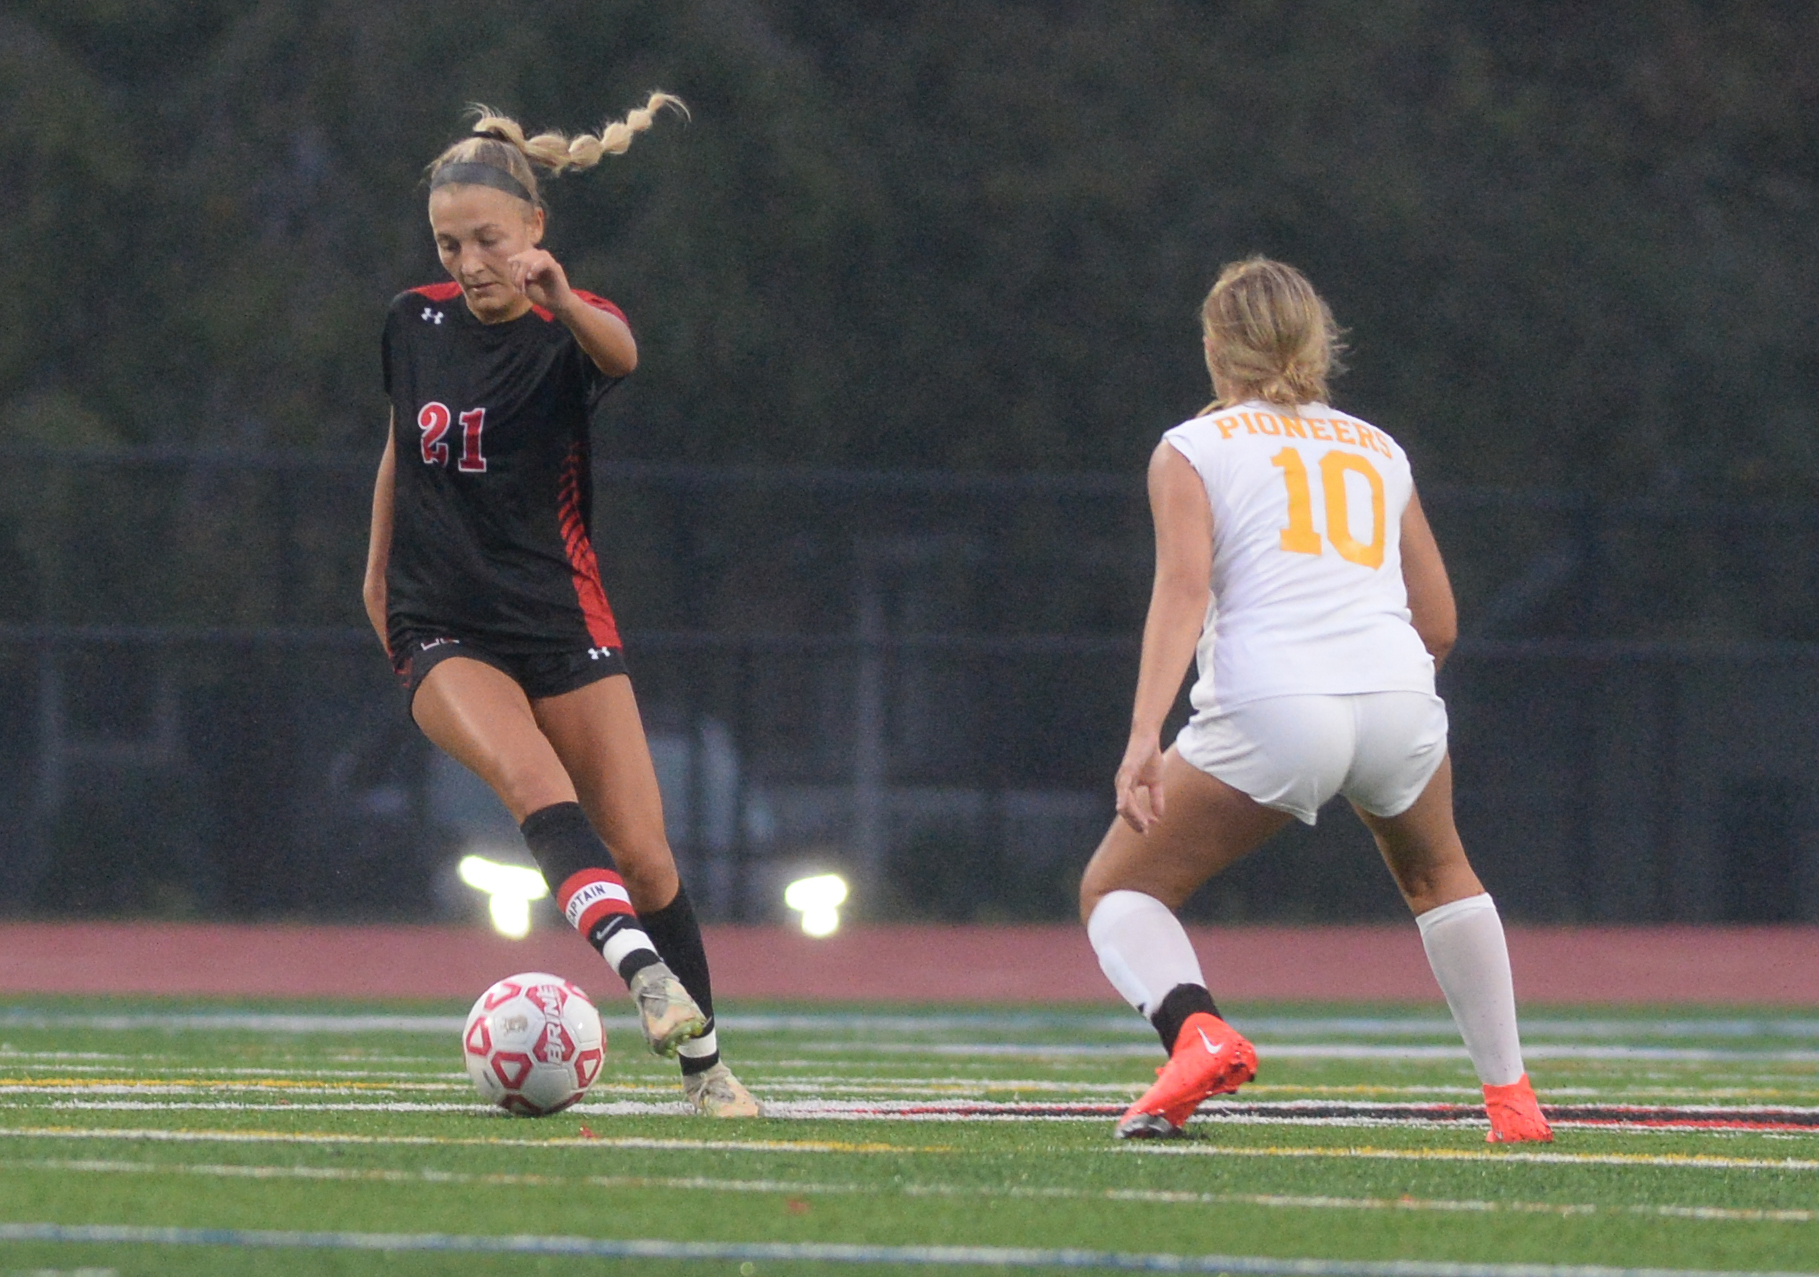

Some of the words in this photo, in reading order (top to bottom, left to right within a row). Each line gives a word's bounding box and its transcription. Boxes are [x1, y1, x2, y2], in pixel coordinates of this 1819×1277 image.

[418, 402, 487, 472] 21
[1213, 412, 1392, 459] PIONEERS
[1270, 446, 1385, 570] 10
[537, 984, 564, 1066] BRINE
